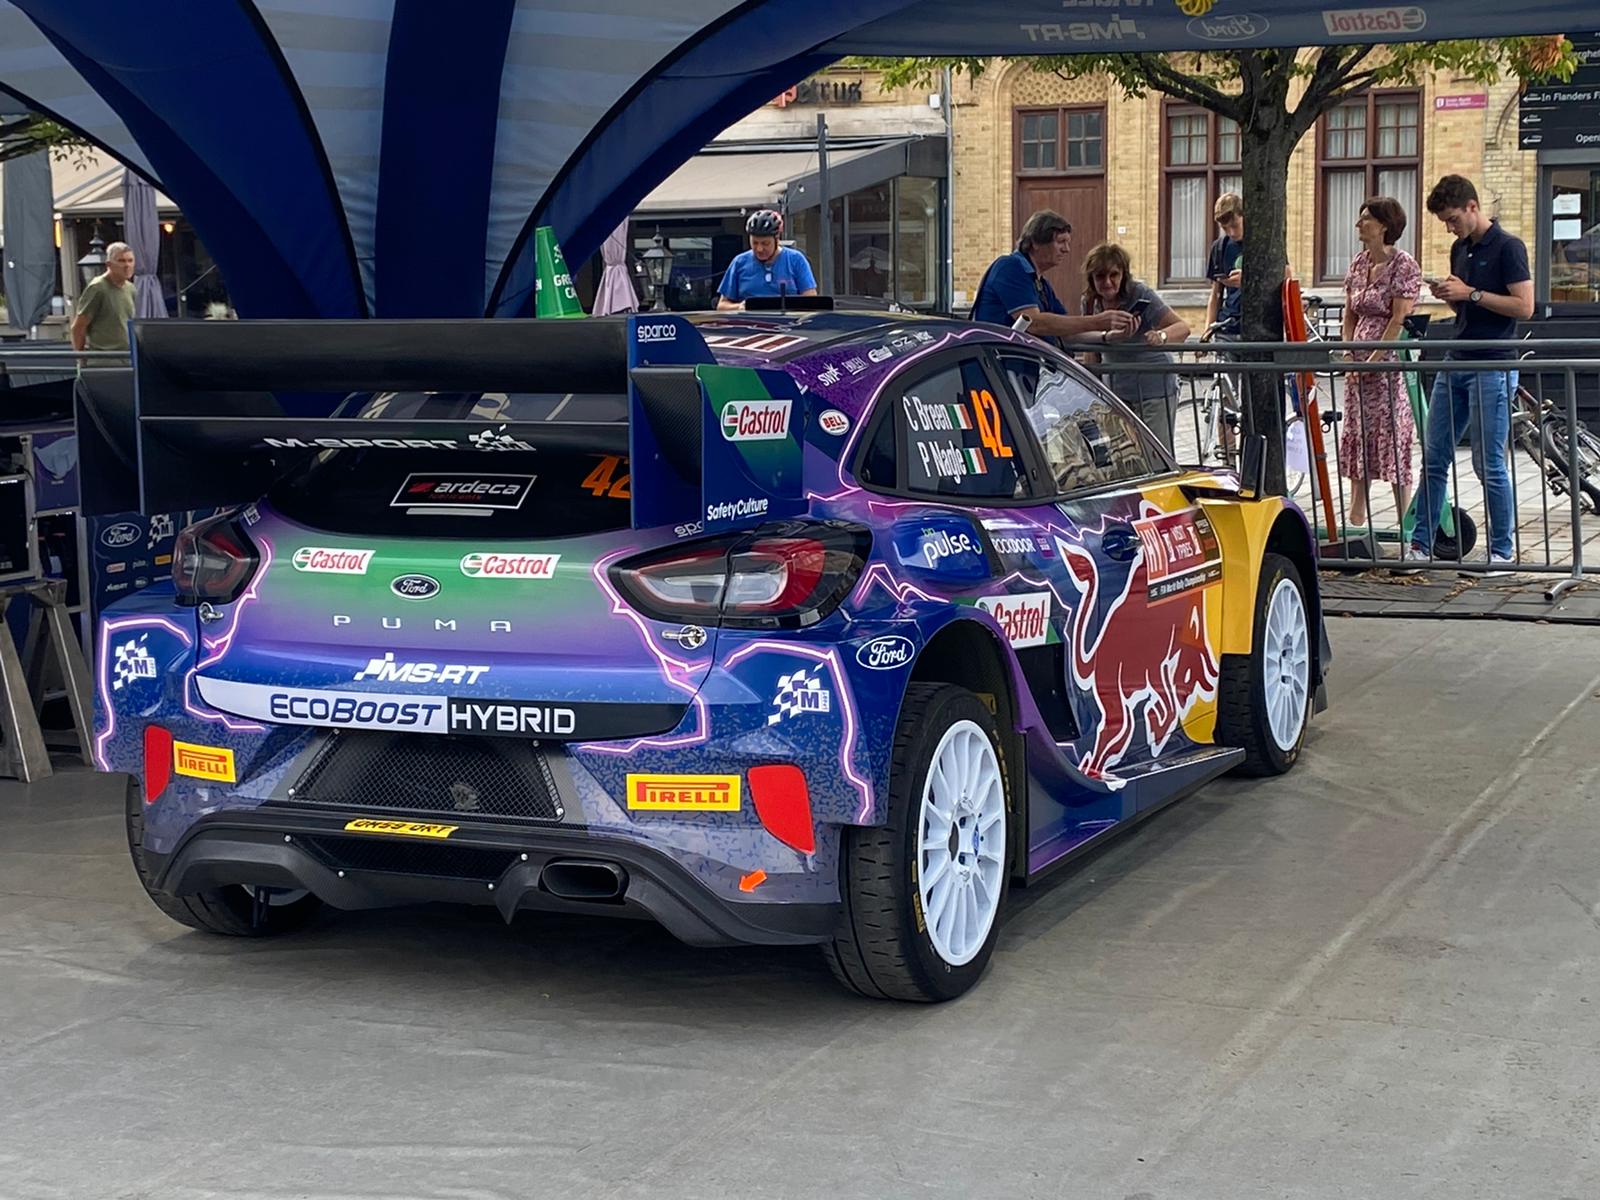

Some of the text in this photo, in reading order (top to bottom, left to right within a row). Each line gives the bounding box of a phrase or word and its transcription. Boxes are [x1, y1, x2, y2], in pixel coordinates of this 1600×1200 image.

[1541, 93, 1551, 102] In
[1553, 92, 1591, 101] Flanders
[1576, 133, 1600, 144] Open
[637, 324, 677, 343] sparco
[739, 405, 787, 436] Castrol
[822, 415, 847, 429] BELL
[902, 396, 954, 431] C Breen
[970, 389, 1013, 458] 42
[263, 437, 458, 450] M-SPORT
[917, 440, 967, 484] P Nagle
[434, 480, 521, 495] ardeca
[707, 497, 769, 521] SafetyCulture
[108, 526, 135, 544] Ford
[310, 550, 366, 570] Castrol
[923, 530, 971, 568] pulse
[482, 554, 553, 575] Castrol
[400, 578, 428, 594] Ford
[333, 615, 512, 632] PUMA
[994, 600, 1046, 641] Castrol
[868, 640, 908, 666] Ford
[376, 662, 490, 684] MS-RT
[270, 693, 443, 727] ECOBOOST
[451, 703, 576, 735] HYBRID
[177, 748, 228, 775] PIRELLI
[636, 781, 730, 803] PIRELLI
